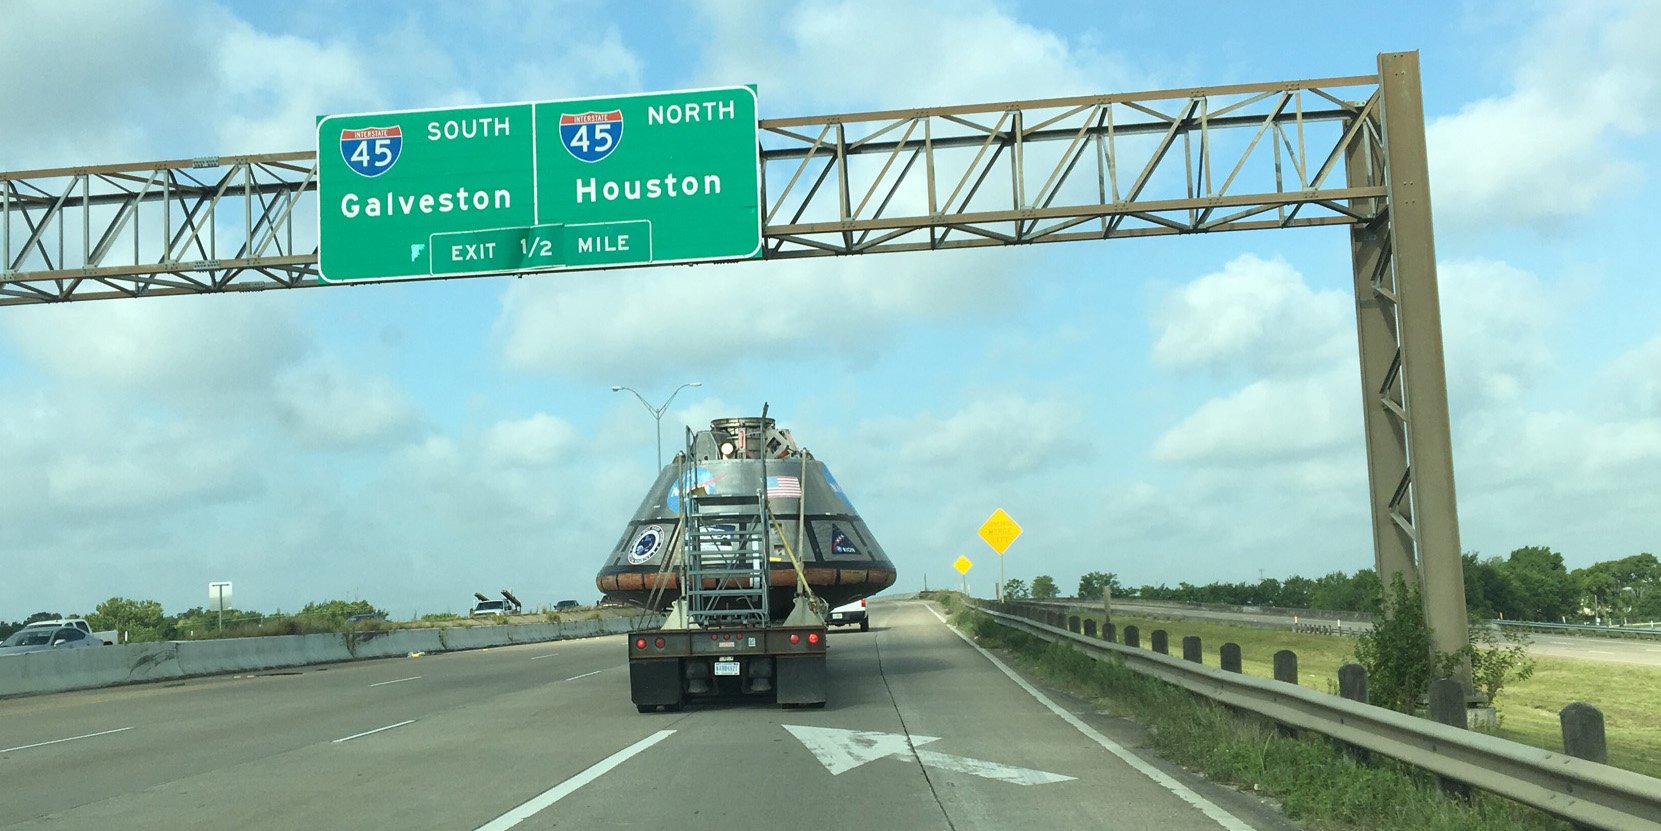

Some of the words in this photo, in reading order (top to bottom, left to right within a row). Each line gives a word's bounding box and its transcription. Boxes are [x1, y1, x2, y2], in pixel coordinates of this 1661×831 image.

[574, 113, 609, 123] INTERSTATE
[648, 100, 735, 126] NORTH
[354, 129, 388, 139] INTERSTATE
[427, 116, 510, 141] SOUTH
[569, 123, 613, 153] 45
[350, 138, 393, 168] 45
[576, 172, 721, 204] Houston
[341, 186, 511, 219] Galveston
[451, 242, 496, 262] EXIT
[520, 236, 553, 259] 1/2
[578, 234, 630, 254] MILE
